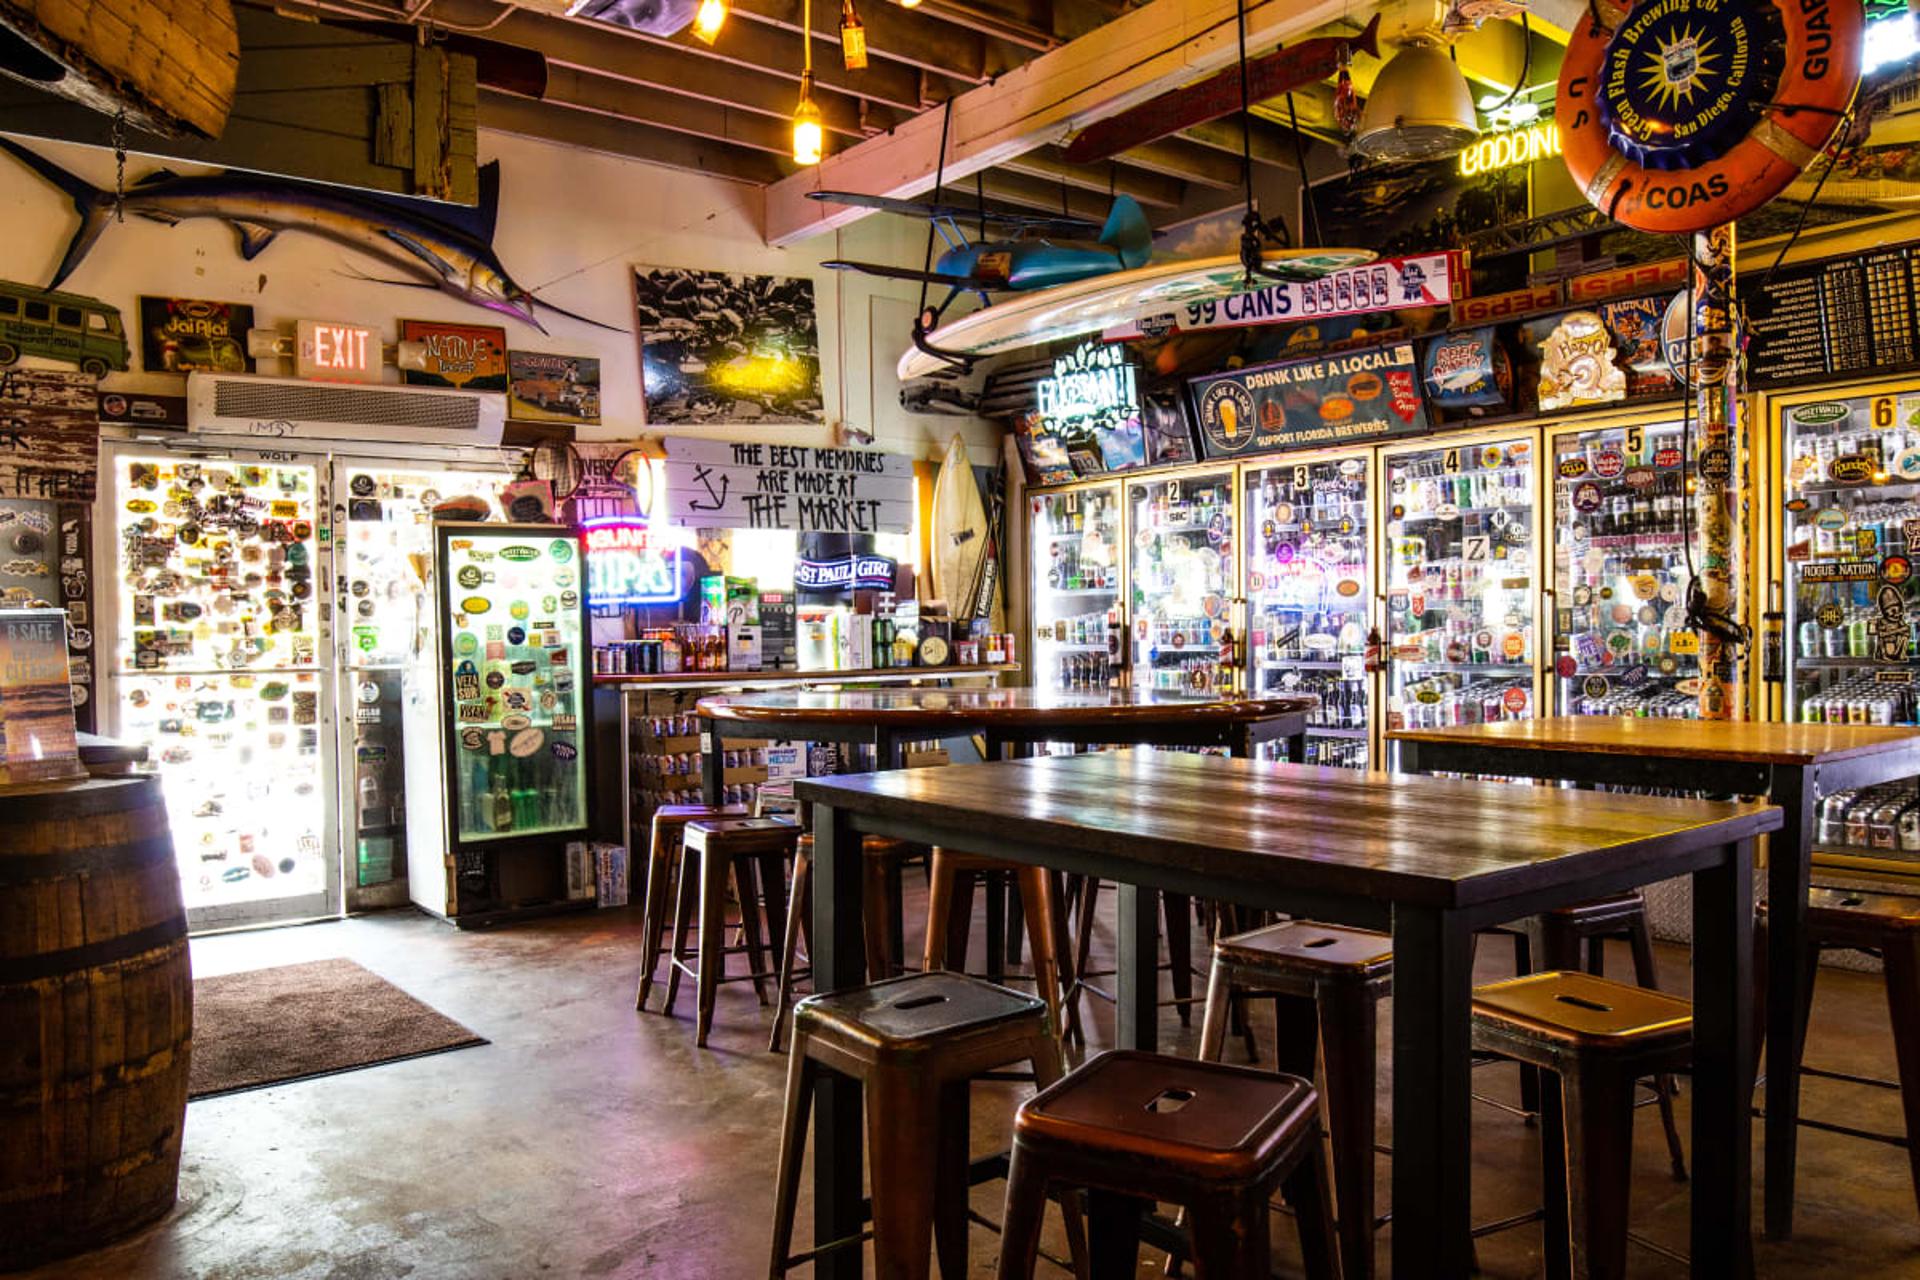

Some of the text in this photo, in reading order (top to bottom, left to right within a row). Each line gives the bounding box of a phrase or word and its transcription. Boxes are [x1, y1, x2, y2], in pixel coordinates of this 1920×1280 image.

[1623, 0, 1691, 45] Brewing
[1608, 48, 1629, 99] Flash
[1673, 15, 1749, 140] San Diego, California
[1615, 101, 1652, 142] Green
[1186, 296, 1217, 326] 99
[1223, 283, 1293, 321] CANS
[1457, 290, 1558, 322] PEPSI
[315, 325, 370, 370] EXIT
[424, 333, 489, 361] NATIVE
[1245, 350, 1395, 391] DRINK LIKE A LOCAL
[1874, 397, 1894, 428] 6
[1256, 419, 1390, 448] SUPPORT FLORIDA BREWERIES
[1627, 428, 1642, 453] 5
[258, 450, 300, 462] WOLF
[730, 443, 887, 473] THE BEST MEMORIES
[1445, 450, 1460, 473] 4
[756, 469, 859, 499] ARE MADE AT
[1169, 481, 1179, 502] 2
[1296, 466, 1307, 488] 3
[742, 495, 882, 532] THE MARKET
[1068, 493, 1076, 511] 1
[1467, 538, 1486, 561] Z
[857, 559, 893, 578] GIRL
[1803, 563, 1836, 578] ROGUE
[1838, 562, 1877, 576] NATION
[20, 623, 53, 641] SAFE
